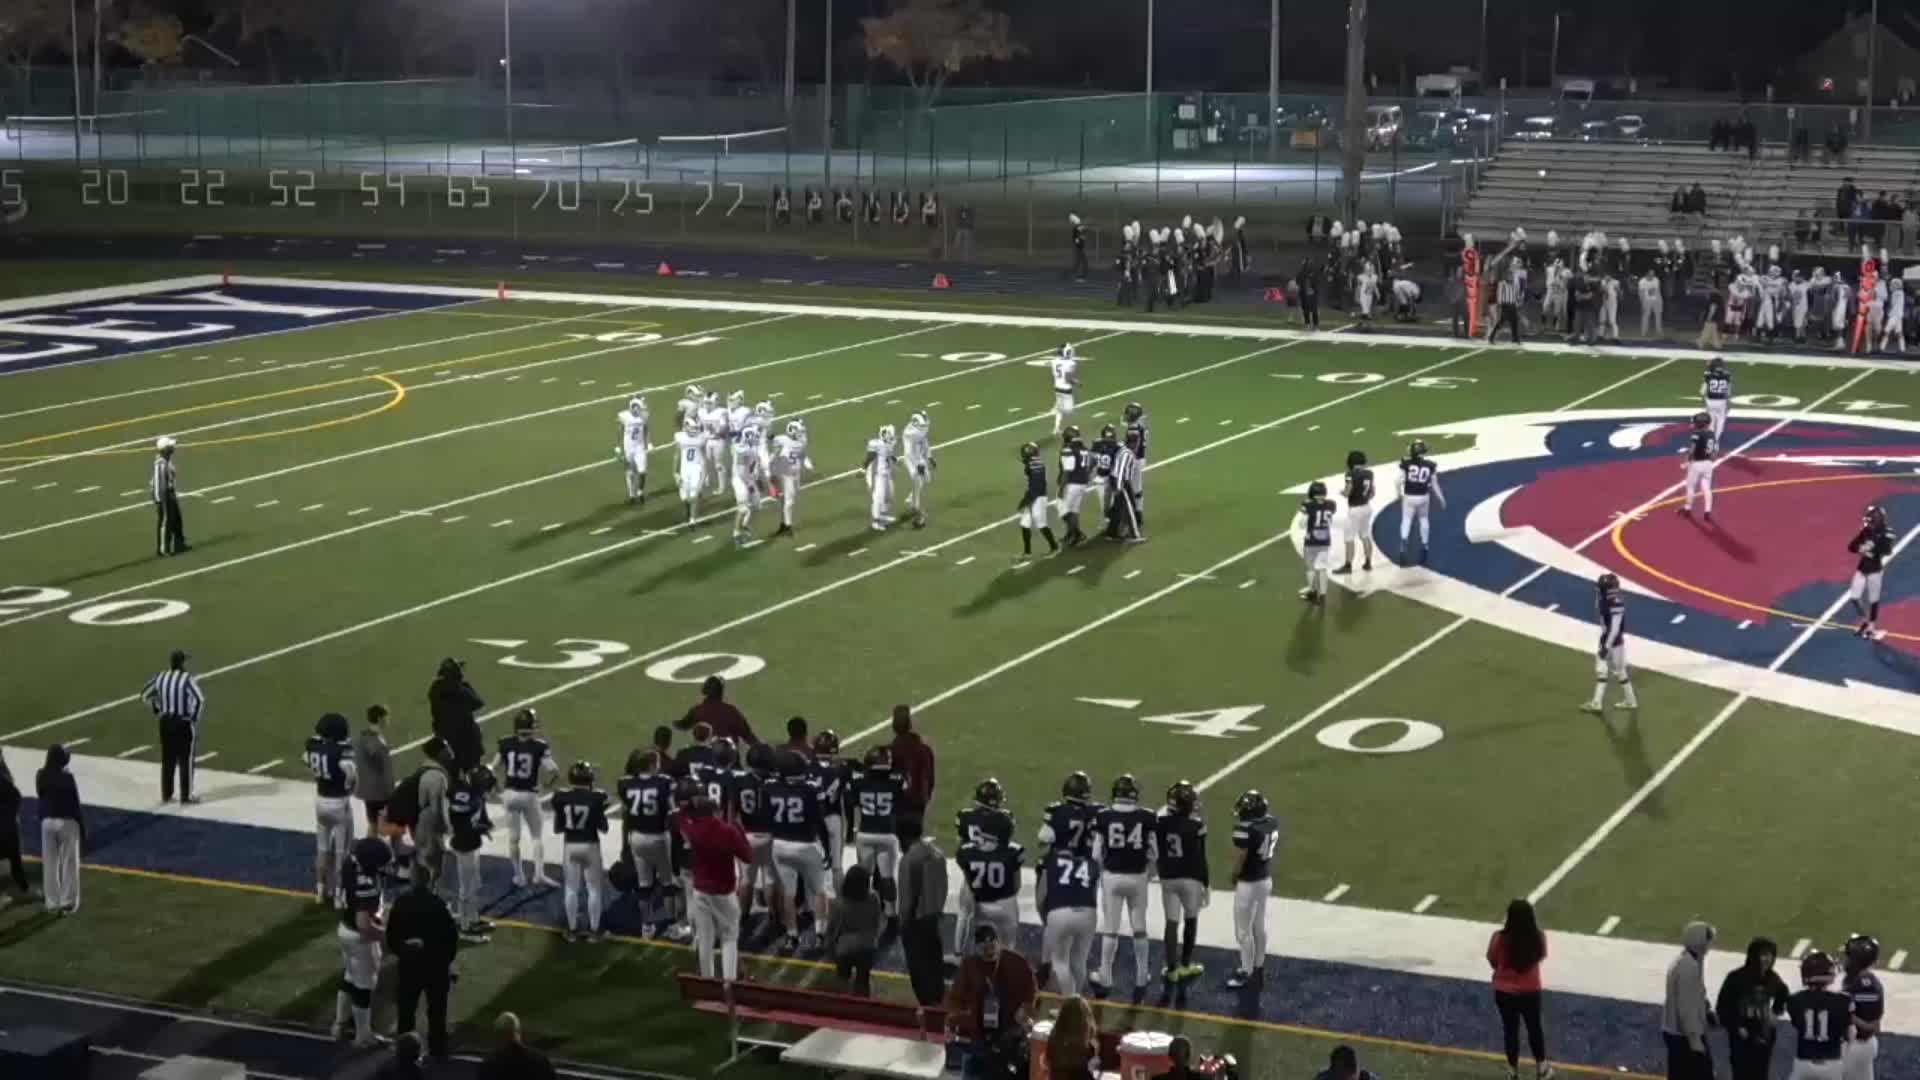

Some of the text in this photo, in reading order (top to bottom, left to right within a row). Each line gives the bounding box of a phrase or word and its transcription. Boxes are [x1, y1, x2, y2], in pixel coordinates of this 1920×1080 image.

[80, 169, 128, 204] 20
[180, 169, 225, 204] 22
[269, 170, 316, 206] 52
[0, 290, 373, 363] EY
[1709, 379, 1728, 393] 22
[1407, 466, 1431, 483] 20
[1315, 510, 1332, 528] 15
[310, 752, 331, 779] 81
[507, 751, 533, 780] 13
[626, 788, 660, 816] 75
[770, 796, 805, 824] 72
[859, 791, 894, 816] 55
[563, 803, 590, 831] 17
[1107, 822, 1143, 850] 64
[1165, 832, 1183, 858] 3
[970, 860, 1006, 889] 70
[1057, 857, 1091, 888] 74
[1804, 1008, 1830, 1042] 11
